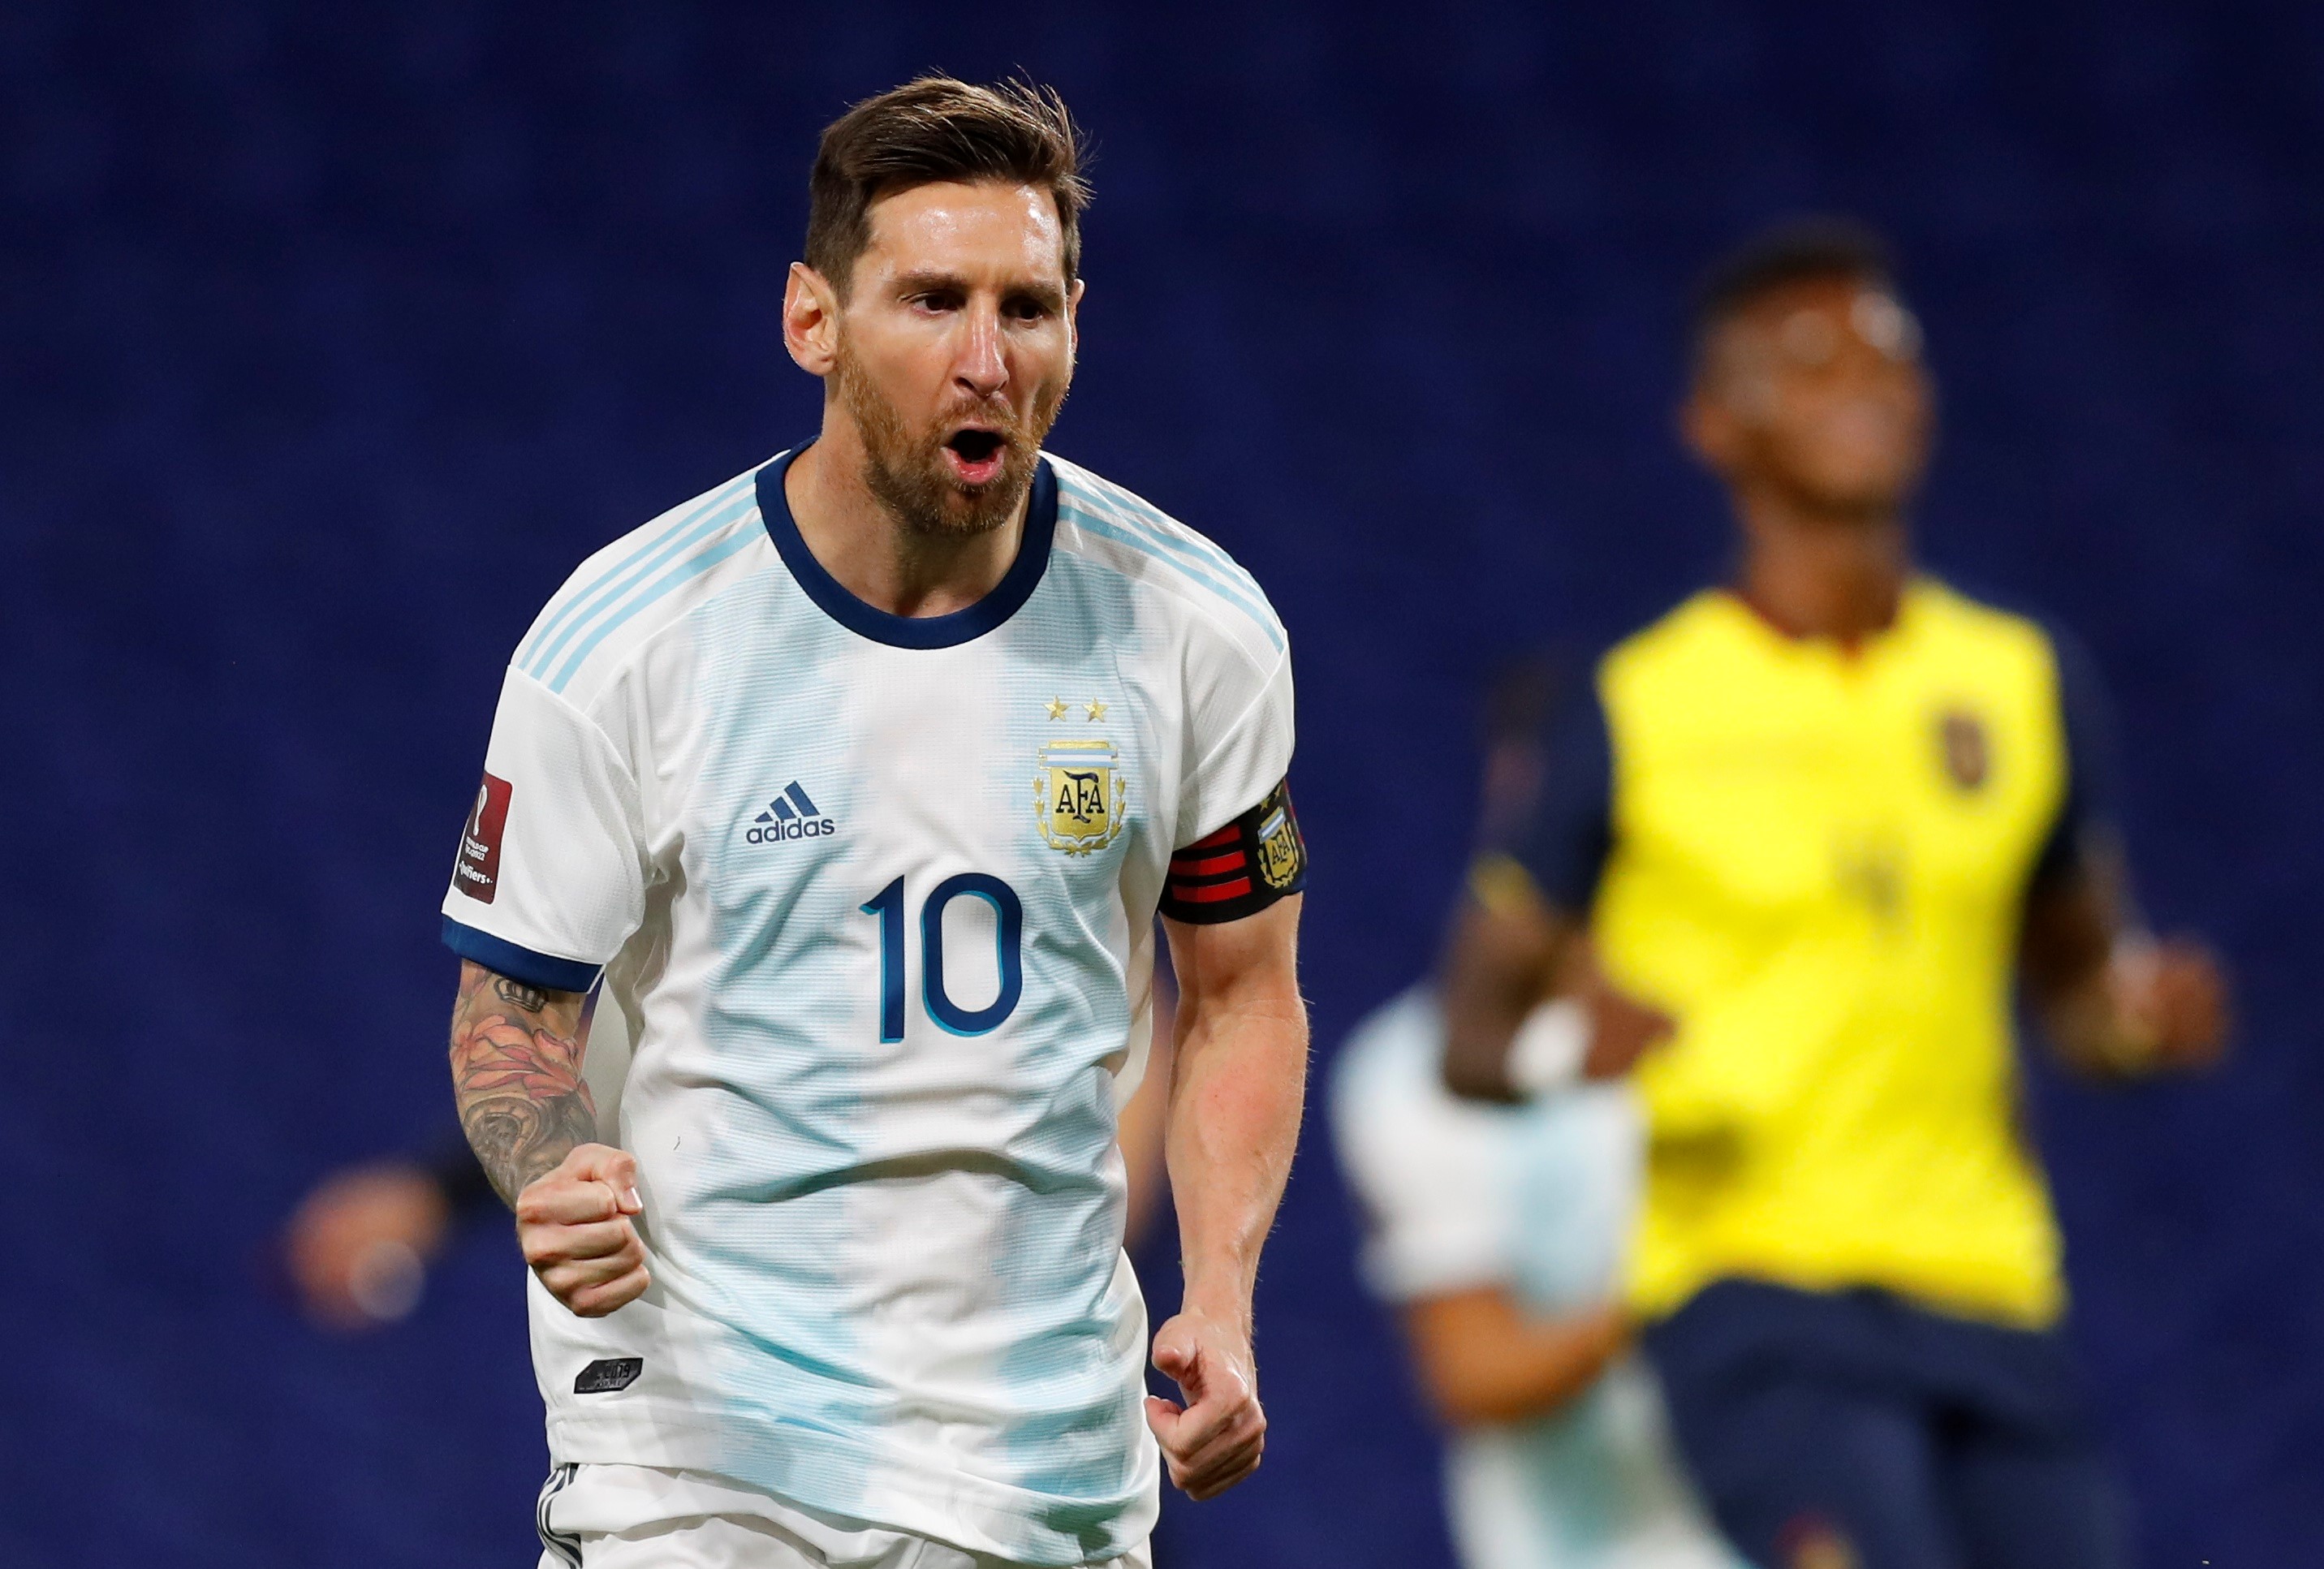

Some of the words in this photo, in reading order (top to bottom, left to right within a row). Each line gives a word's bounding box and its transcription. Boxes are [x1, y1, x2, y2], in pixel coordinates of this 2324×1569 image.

[1055, 770, 1105, 824] AFA
[746, 817, 835, 844] adidas
[858, 872, 1023, 1045] 10
